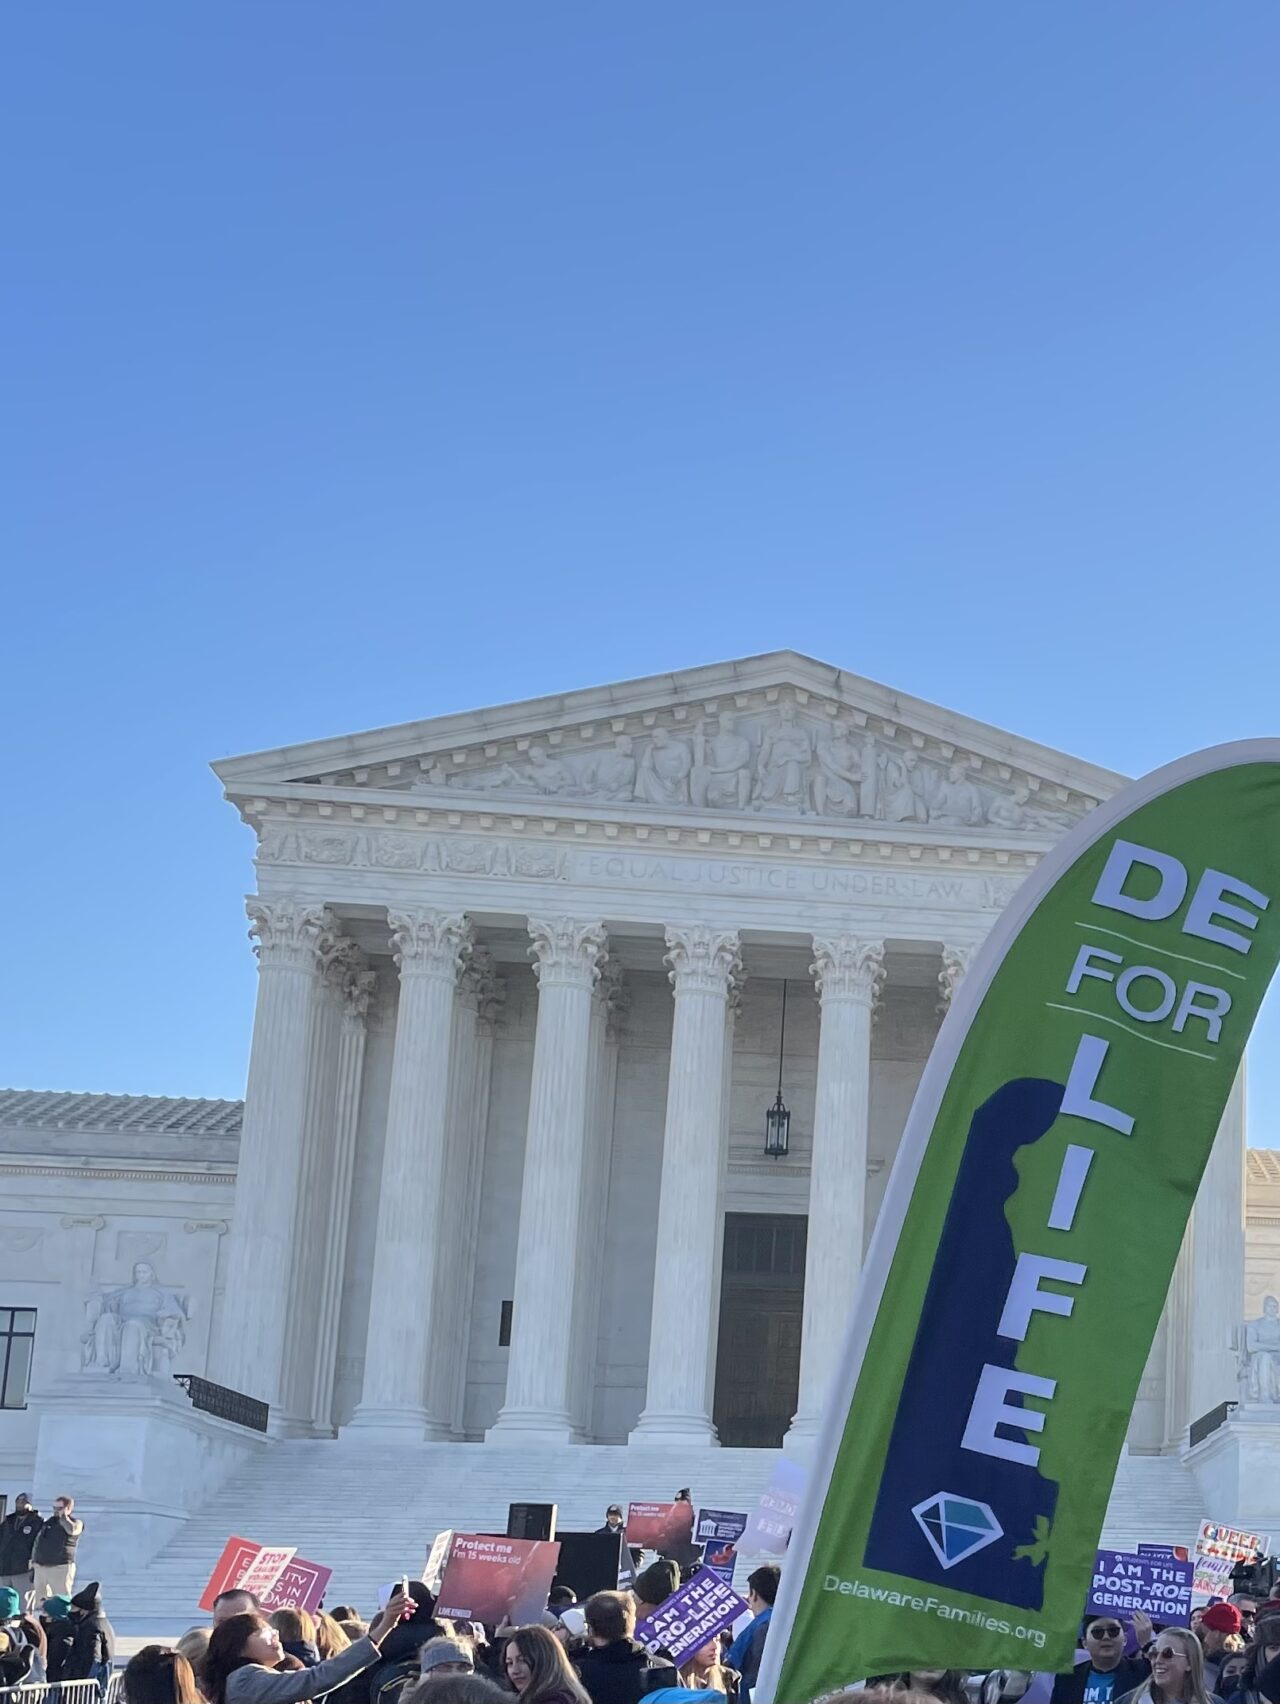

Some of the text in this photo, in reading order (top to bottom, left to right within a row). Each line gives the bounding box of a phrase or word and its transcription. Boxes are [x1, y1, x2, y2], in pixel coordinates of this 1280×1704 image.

[690, 864, 798, 889] JUSTICE
[912, 878, 963, 899] LAW
[1091, 839, 1270, 954] DE
[1065, 944, 1232, 1043] FOR
[960, 1033, 1136, 1468] LIFE
[455, 1537, 512, 1553] Protect me
[1203, 1524, 1262, 1550] QUEER
[259, 1553, 288, 1564] STOP
[453, 1549, 521, 1565] I'm 15 weeks old
[1099, 1560, 1105, 1572] I
[1112, 1563, 1142, 1577] AM
[1150, 1567, 1186, 1583] THE
[263, 1591, 297, 1609] OMB
[287, 1586, 302, 1598] IN
[1092, 1574, 1193, 1601] POST-ROE
[438, 1606, 452, 1616] LIVE
[639, 1577, 715, 1642] I AM THE
[823, 1574, 1047, 1648] DelawareFamilies.org
[1092, 1591, 1187, 1616] GENERATION
[645, 1582, 731, 1655] PRO-LIFE
[667, 1595, 740, 1658] ENERATION
